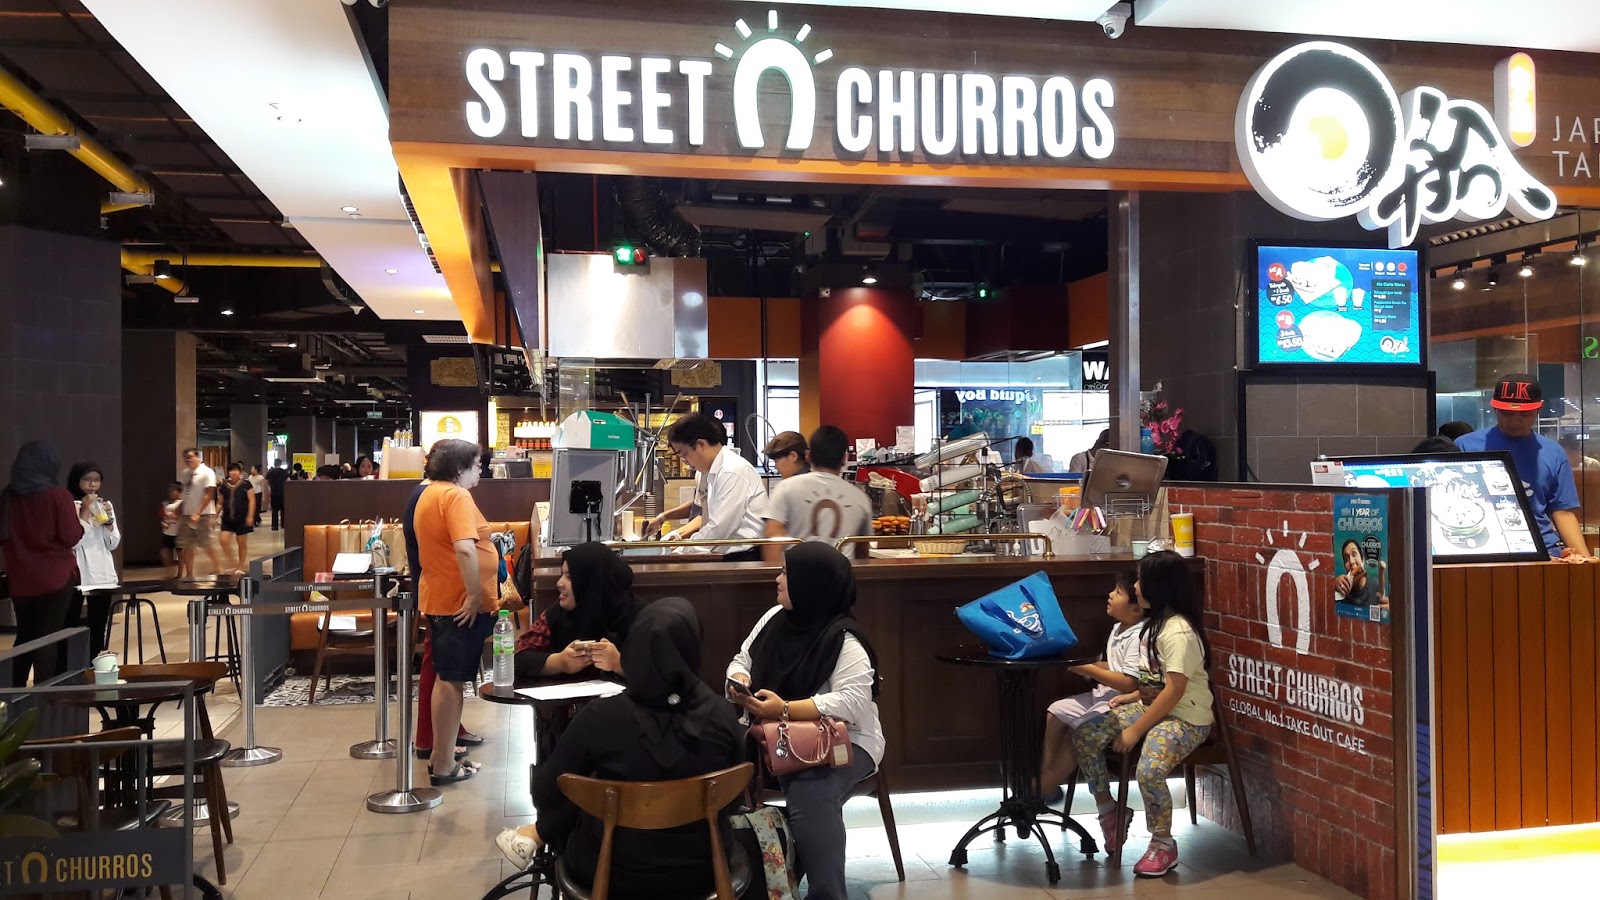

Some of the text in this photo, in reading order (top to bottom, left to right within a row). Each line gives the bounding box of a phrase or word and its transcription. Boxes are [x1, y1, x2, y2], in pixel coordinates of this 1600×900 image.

[465, 48, 1115, 160] STREET CHURROS
[1552, 150, 1600, 178] TA
[1500, 381, 1532, 400] LK
[1356, 508, 1370, 517] YEAR
[1338, 517, 1383, 533] CHURROS
[232, 607, 253, 615] CHURROS
[308, 604, 330, 612] CHURROS
[1228, 654, 1365, 726] STREET CHURROS
[1229, 698, 1264, 721] GLOBAL
[1285, 716, 1310, 736] TAKE
[1312, 724, 1333, 744] OUT
[1337, 732, 1367, 754] CAFE
[56, 852, 153, 883] CHURROS
